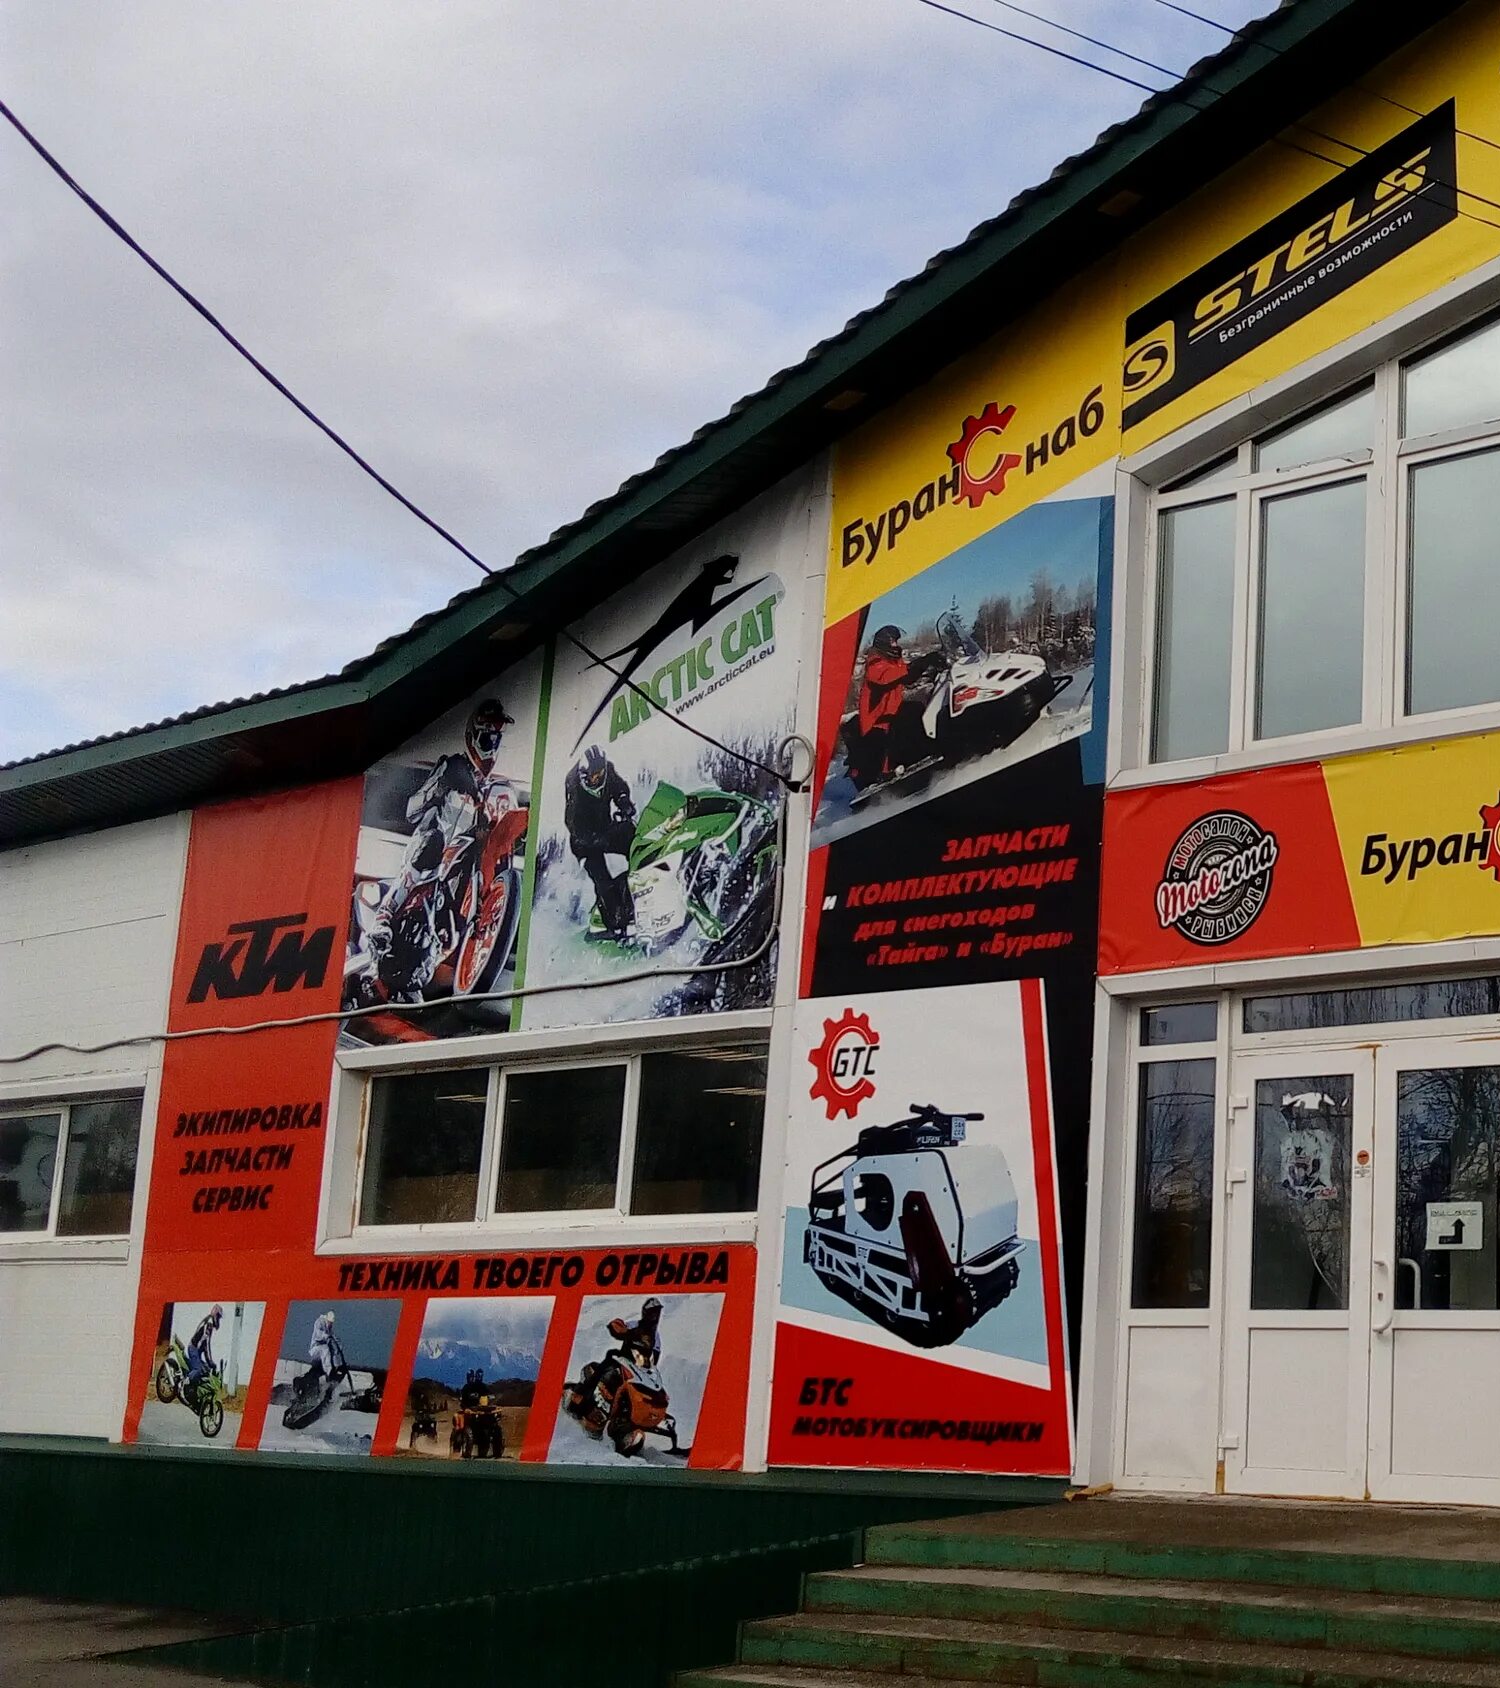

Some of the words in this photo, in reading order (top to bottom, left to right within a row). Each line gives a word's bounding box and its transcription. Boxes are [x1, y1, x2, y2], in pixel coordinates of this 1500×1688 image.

[1188, 147, 1431, 338] STELS
[1218, 274, 1315, 343] Безграничные
[1318, 211, 1413, 280] возможности
[609, 636, 715, 743] ARCTIC
[720, 593, 778, 665] CAT
[675, 645, 775, 715] www.arcticcat.eu
[942, 824, 1070, 862] ЗАПЧАСТИ
[822, 895, 837, 911] и
[845, 858, 1079, 908] КОМПЛЕКТУЮЩИЕ
[1157, 834, 1277, 927] Motozona
[854, 919, 895, 942] для
[903, 903, 1036, 933] снегоходов
[1191, 887, 1262, 938] РЫБИНСК
[186, 912, 336, 1004] KTM
[867, 944, 948, 966] «Тайга»
[956, 942, 970, 958] и
[980, 932, 1073, 959] «Буран»
[173, 1102, 322, 1139] ЭКИПИРОВКА
[178, 1144, 295, 1174] ЗАПЧАСТИ
[192, 1184, 274, 1215] СЕРВИС
[336, 1259, 460, 1292] ТЕХНИКА
[473, 1256, 585, 1290] ТВОЕГО
[595, 1251, 730, 1287] ОТРЫВА
[798, 1377, 854, 1406] БТС
[792, 1416, 1045, 1445] МОТОБУКСИРОВЩИКИ
